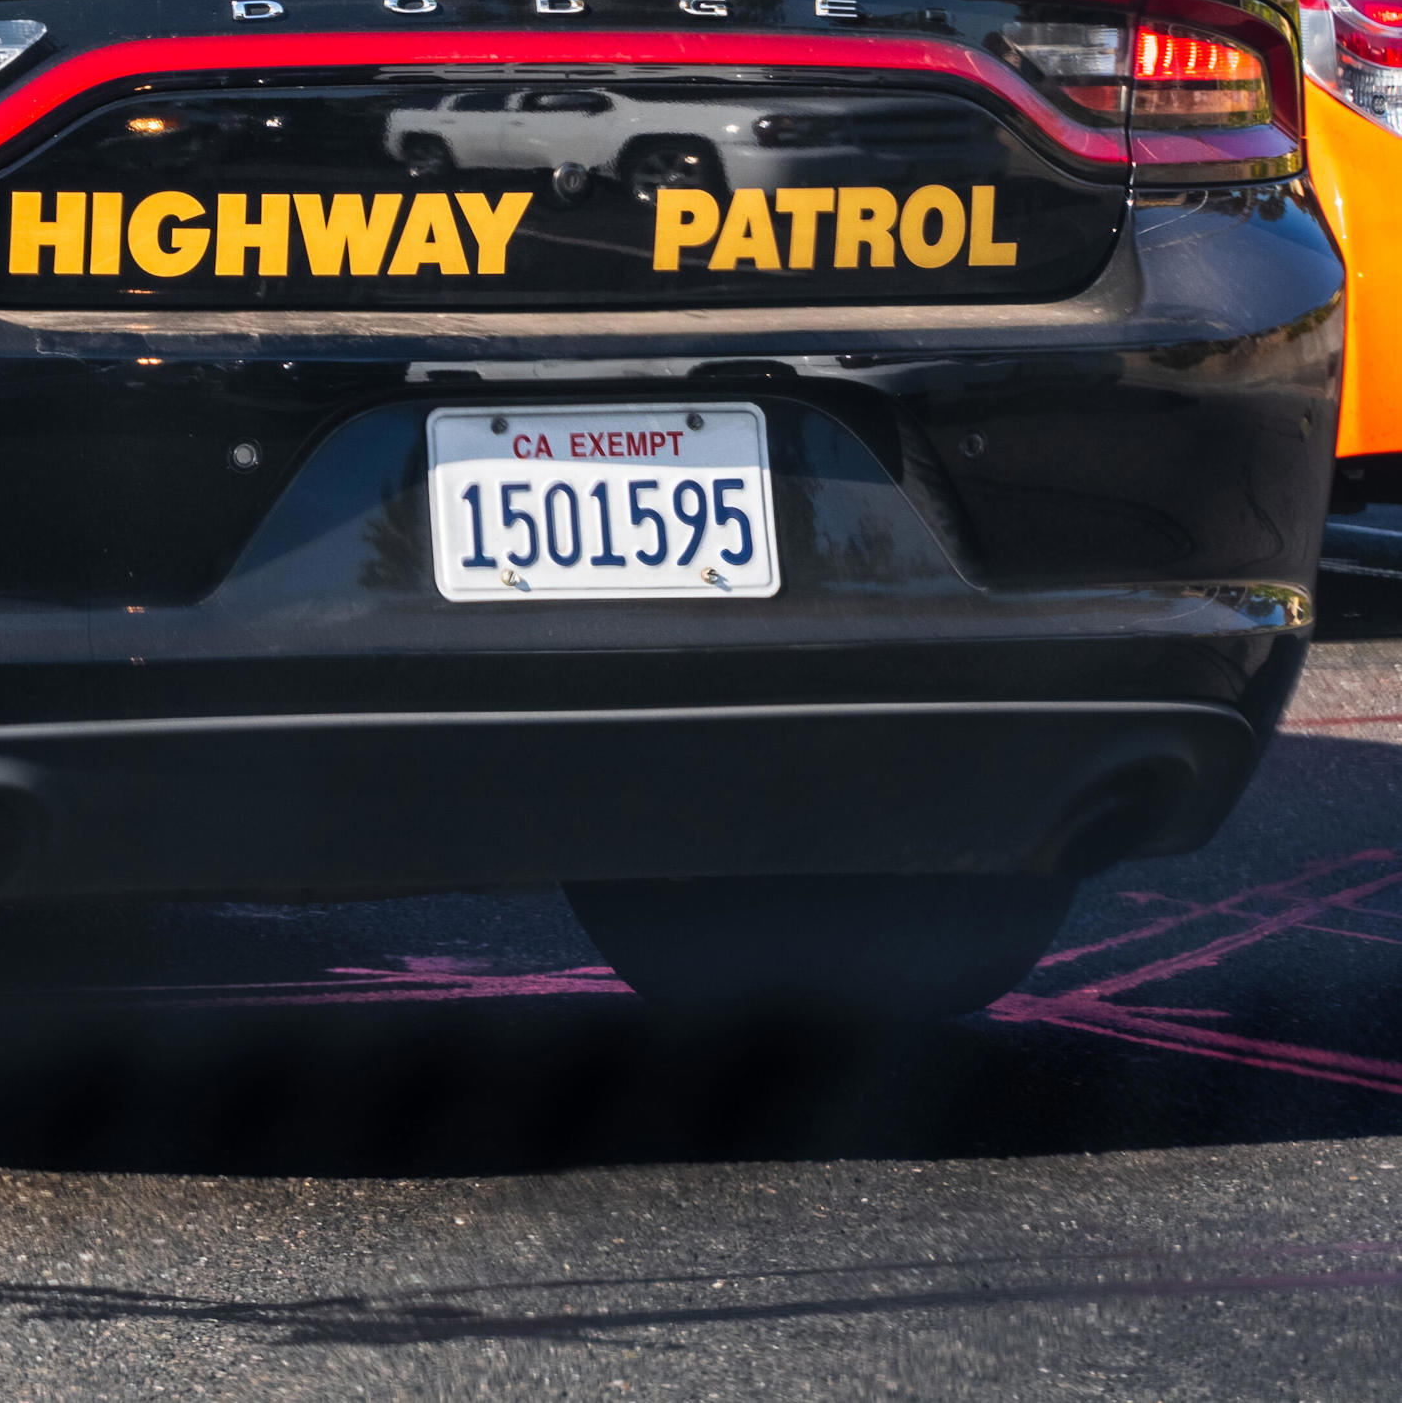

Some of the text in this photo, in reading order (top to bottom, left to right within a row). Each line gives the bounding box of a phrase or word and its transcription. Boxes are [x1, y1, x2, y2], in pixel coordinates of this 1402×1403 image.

[8, 184, 1018, 277] HIGHWAY PATROL
[512, 430, 685, 460] CA EXEMPT
[461, 478, 754, 568] 1501595
